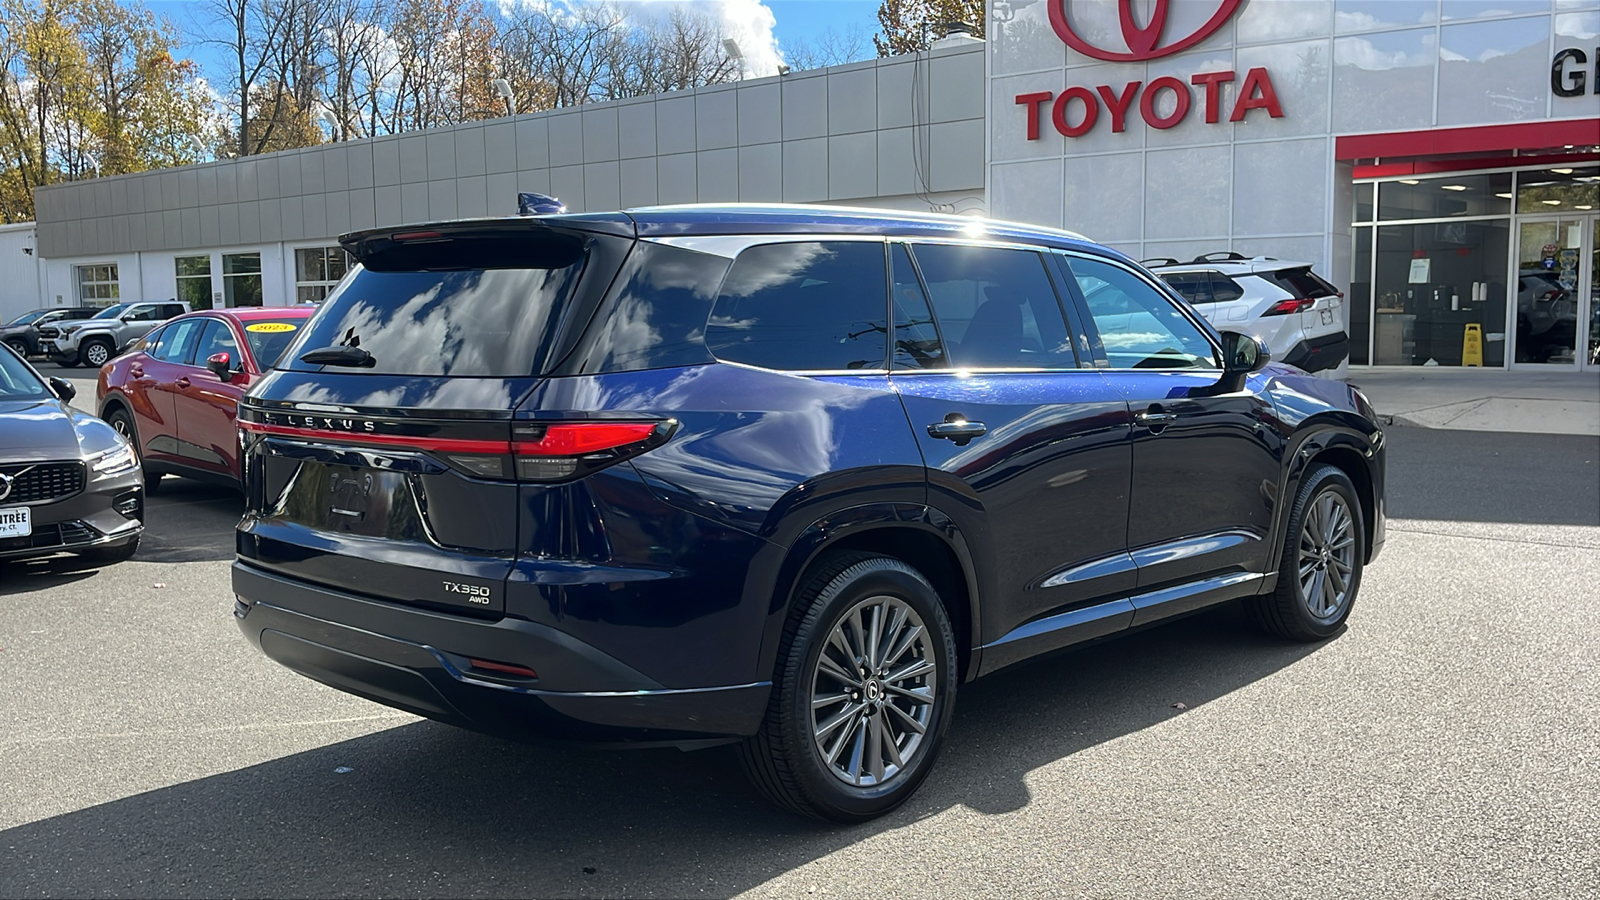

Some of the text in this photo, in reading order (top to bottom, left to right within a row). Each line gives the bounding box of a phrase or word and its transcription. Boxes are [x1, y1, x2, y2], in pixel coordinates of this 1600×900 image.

[1551, 47, 1600, 97] G
[1015, 67, 1285, 141] TOYOTA
[288, 416, 375, 431] LEXUS
[443, 581, 490, 596] TX350
[469, 596, 490, 604] AWD
